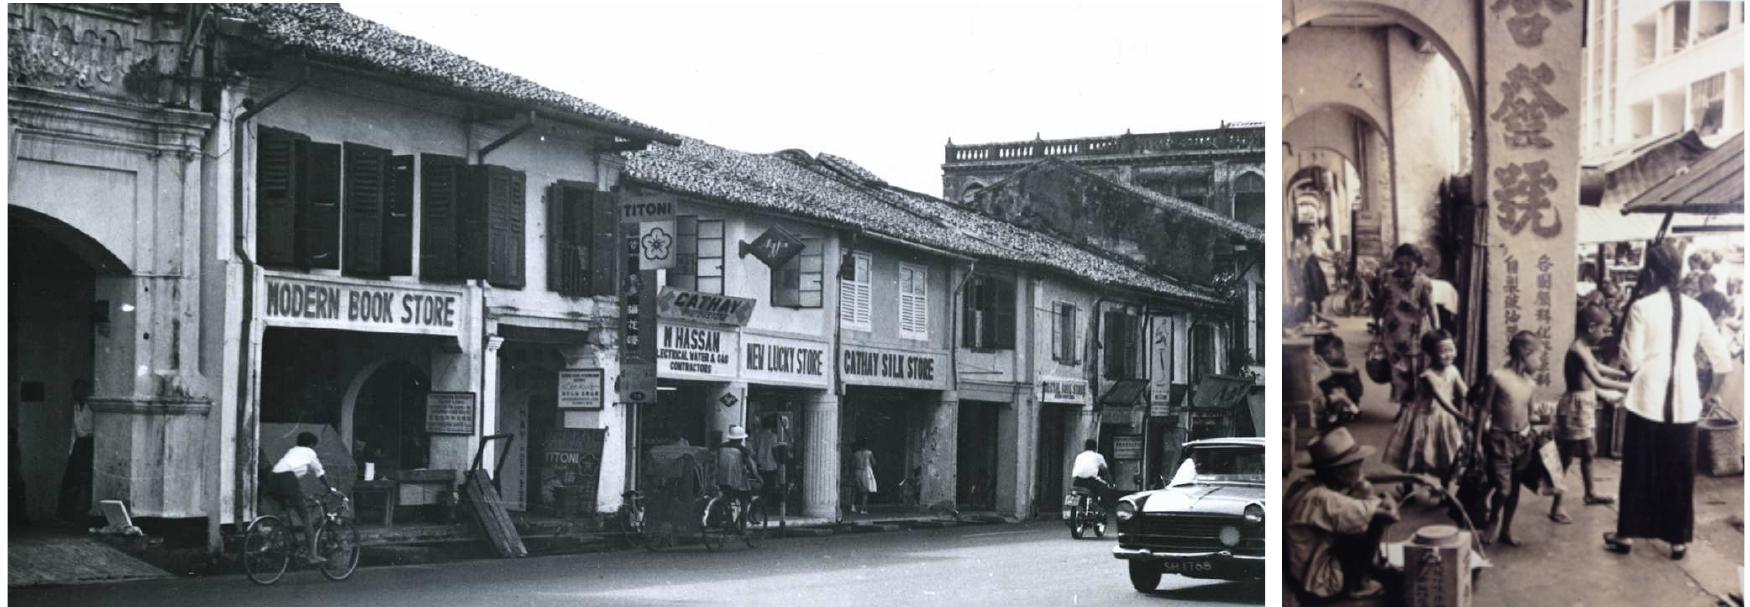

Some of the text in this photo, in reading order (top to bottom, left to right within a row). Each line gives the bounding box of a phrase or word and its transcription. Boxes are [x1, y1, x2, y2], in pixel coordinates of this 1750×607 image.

[624, 203, 672, 217] TITONI
[267, 282, 455, 328] MODERN BOOK STORE
[673, 292, 742, 314] CATHAY
[675, 327, 720, 353] HASSAN
[657, 347, 688, 361] LECTRICAL
[689, 351, 709, 363] WATER
[746, 342, 823, 376] NEW LUCKY STORE
[844, 349, 934, 381] CATHAY SILK STORE
[670, 361, 712, 374] CONTRACTORS
[545, 452, 579, 463] TITONI
